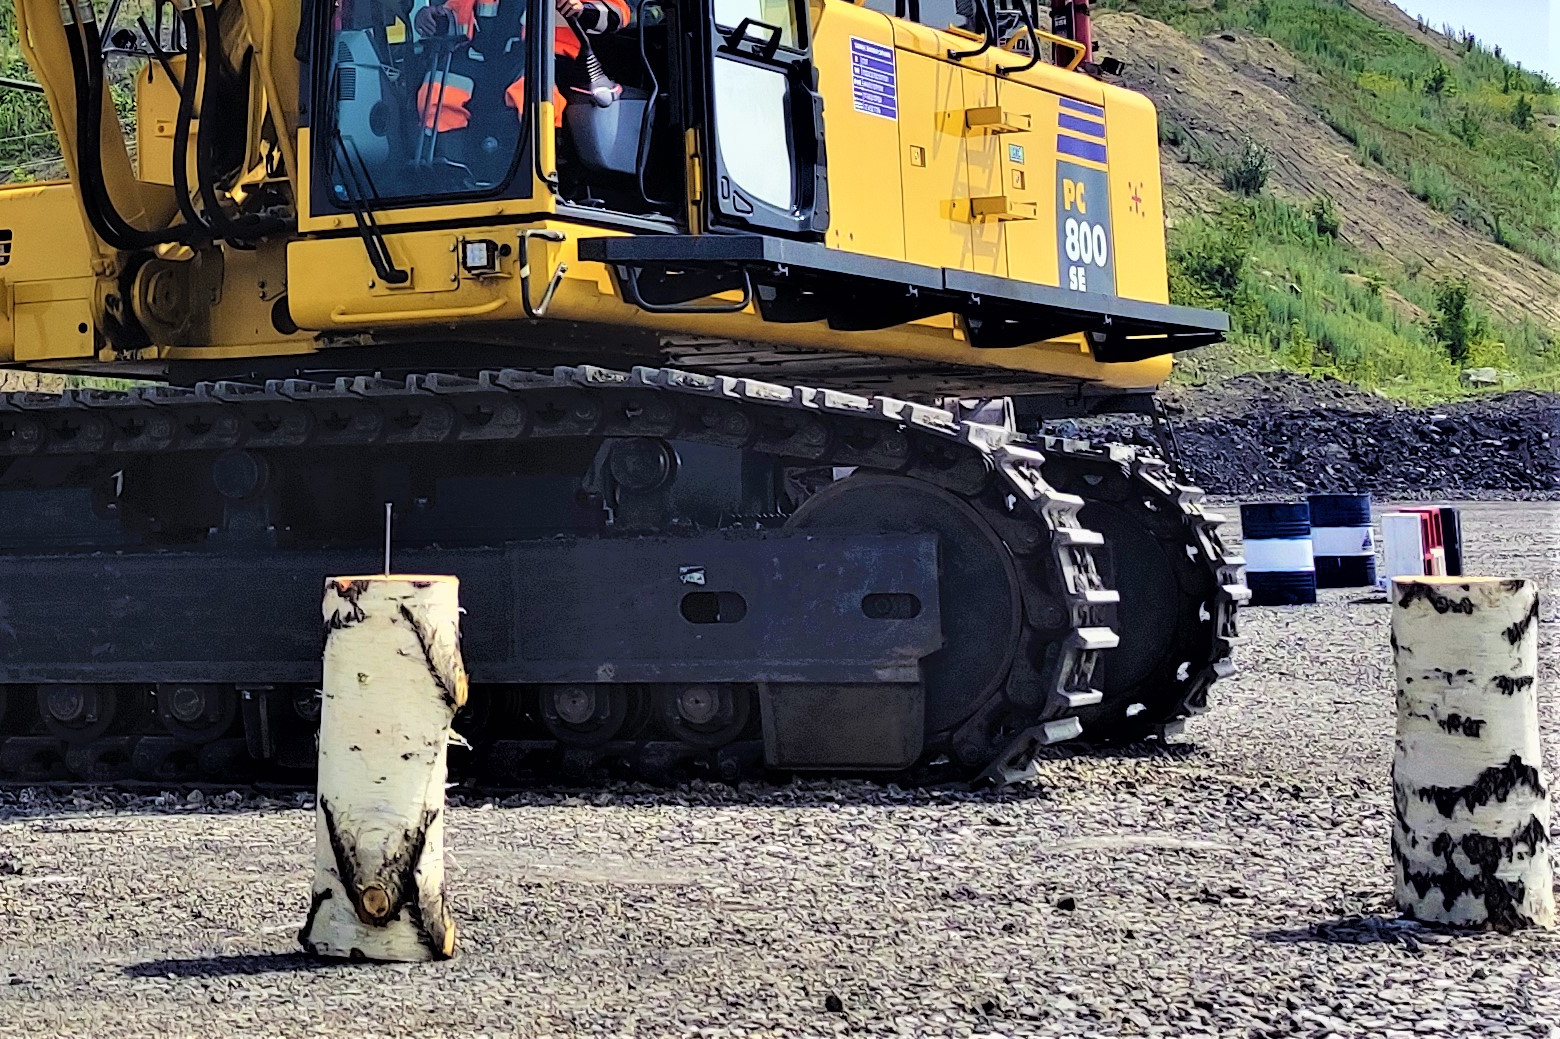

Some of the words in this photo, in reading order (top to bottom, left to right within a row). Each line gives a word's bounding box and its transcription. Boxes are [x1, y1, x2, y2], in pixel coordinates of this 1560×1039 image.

[1063, 178, 1087, 214] PC
[1065, 217, 1108, 267] 800
[1069, 265, 1087, 292] SE
